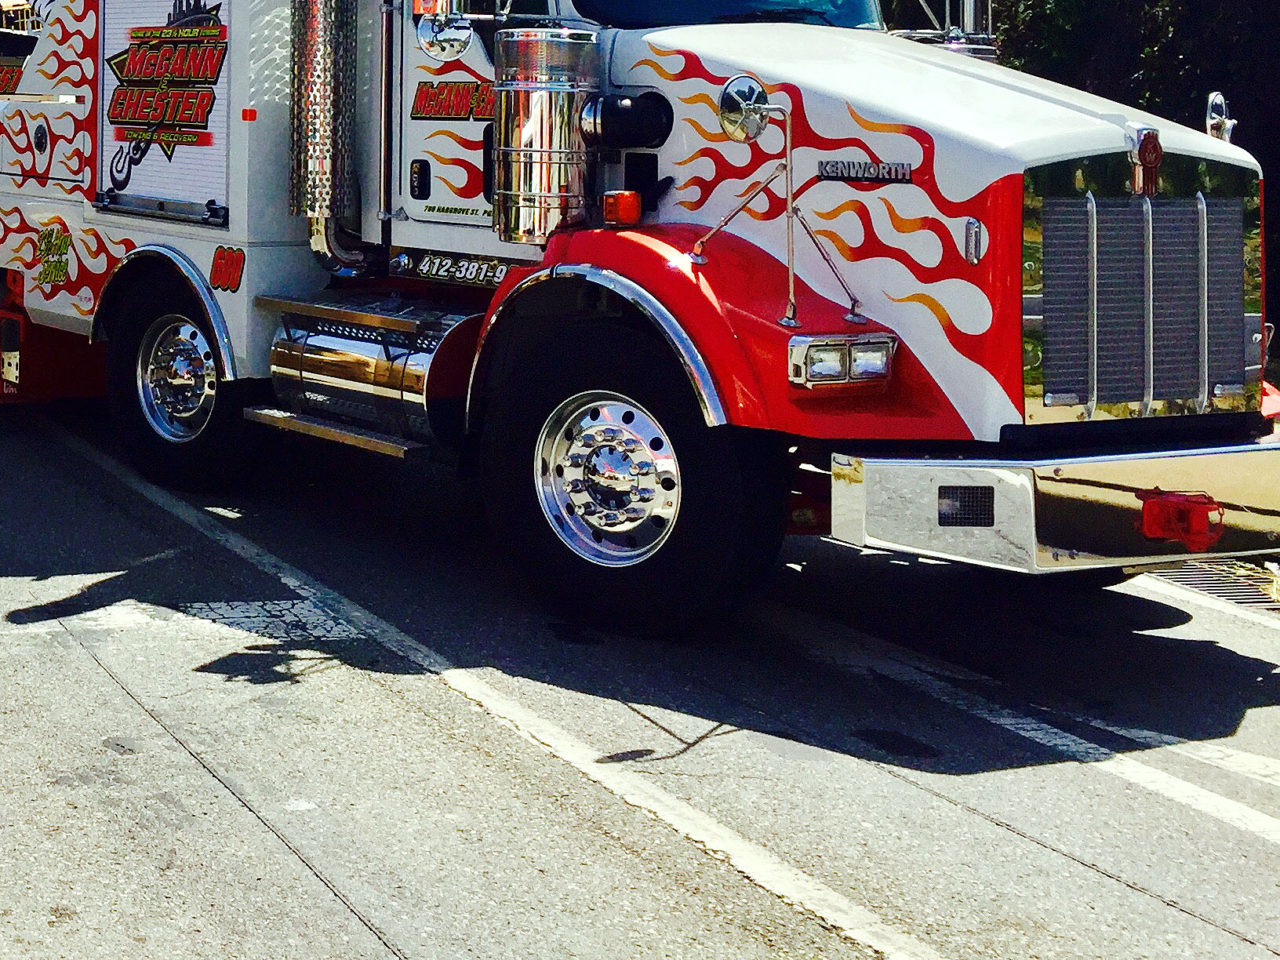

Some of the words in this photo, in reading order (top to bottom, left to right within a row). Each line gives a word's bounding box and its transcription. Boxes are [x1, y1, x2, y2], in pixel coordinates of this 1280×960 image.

[178, 28, 199, 38] HOUR
[108, 88, 215, 124] CHESTER
[124, 130, 151, 140] TOWING
[160, 132, 199, 142] RECOVERY
[817, 160, 912, 181] KENWORTH
[418, 255, 508, 285] 412-381-9
